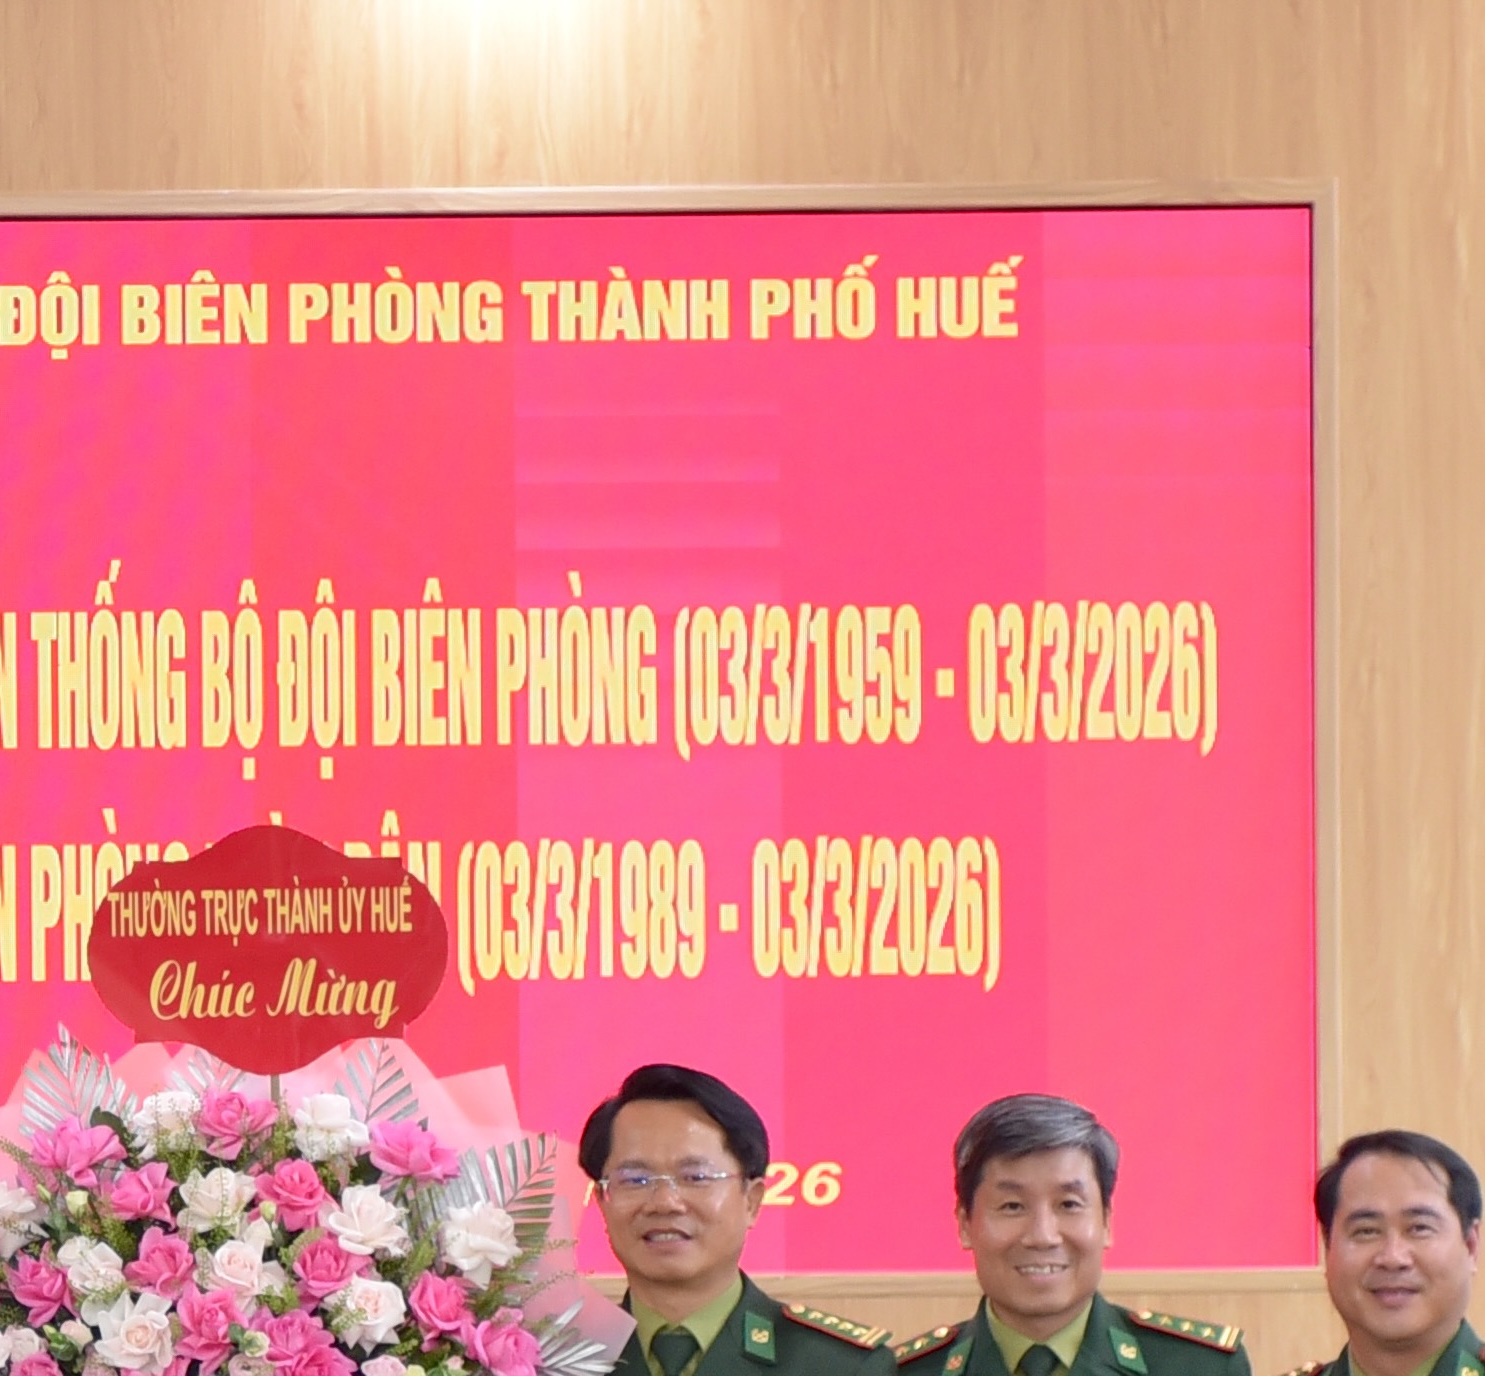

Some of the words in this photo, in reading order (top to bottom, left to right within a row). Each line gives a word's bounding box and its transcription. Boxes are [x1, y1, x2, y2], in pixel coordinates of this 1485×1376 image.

[121, 270, 269, 346] BIÊN
[288, 266, 504, 344] PHÒNG
[520, 266, 730, 342] THÀNH
[750, 255, 879, 340] PHỐ
[896, 255, 1023, 339] HUẾ
[30, 559, 187, 751] THỐNG
[201, 578, 264, 781] BỘ
[276, 578, 357, 780] ĐỘI
[371, 577, 482, 748] BIÊN
[496, 570, 658, 748] PHÒNG
[673, 602, 922, 762] (03/3/1959
[935, 668, 955, 698] -
[968, 600, 1218, 758] 03/3/2026)
[107, 877, 197, 938] THƯỜNG
[200, 888, 259, 947] TRỰC
[263, 879, 333, 935] THÀNH
[338, 876, 366, 934] ỦY
[370, 875, 413, 933] HUẾ
[457, 837, 707, 997] (03/3/1989
[718, 903, 739, 933] -
[751, 834, 1001, 992] 03/3/2026)
[149, 959, 256, 1021] Chúc
[266, 957, 400, 1030] Mừng
